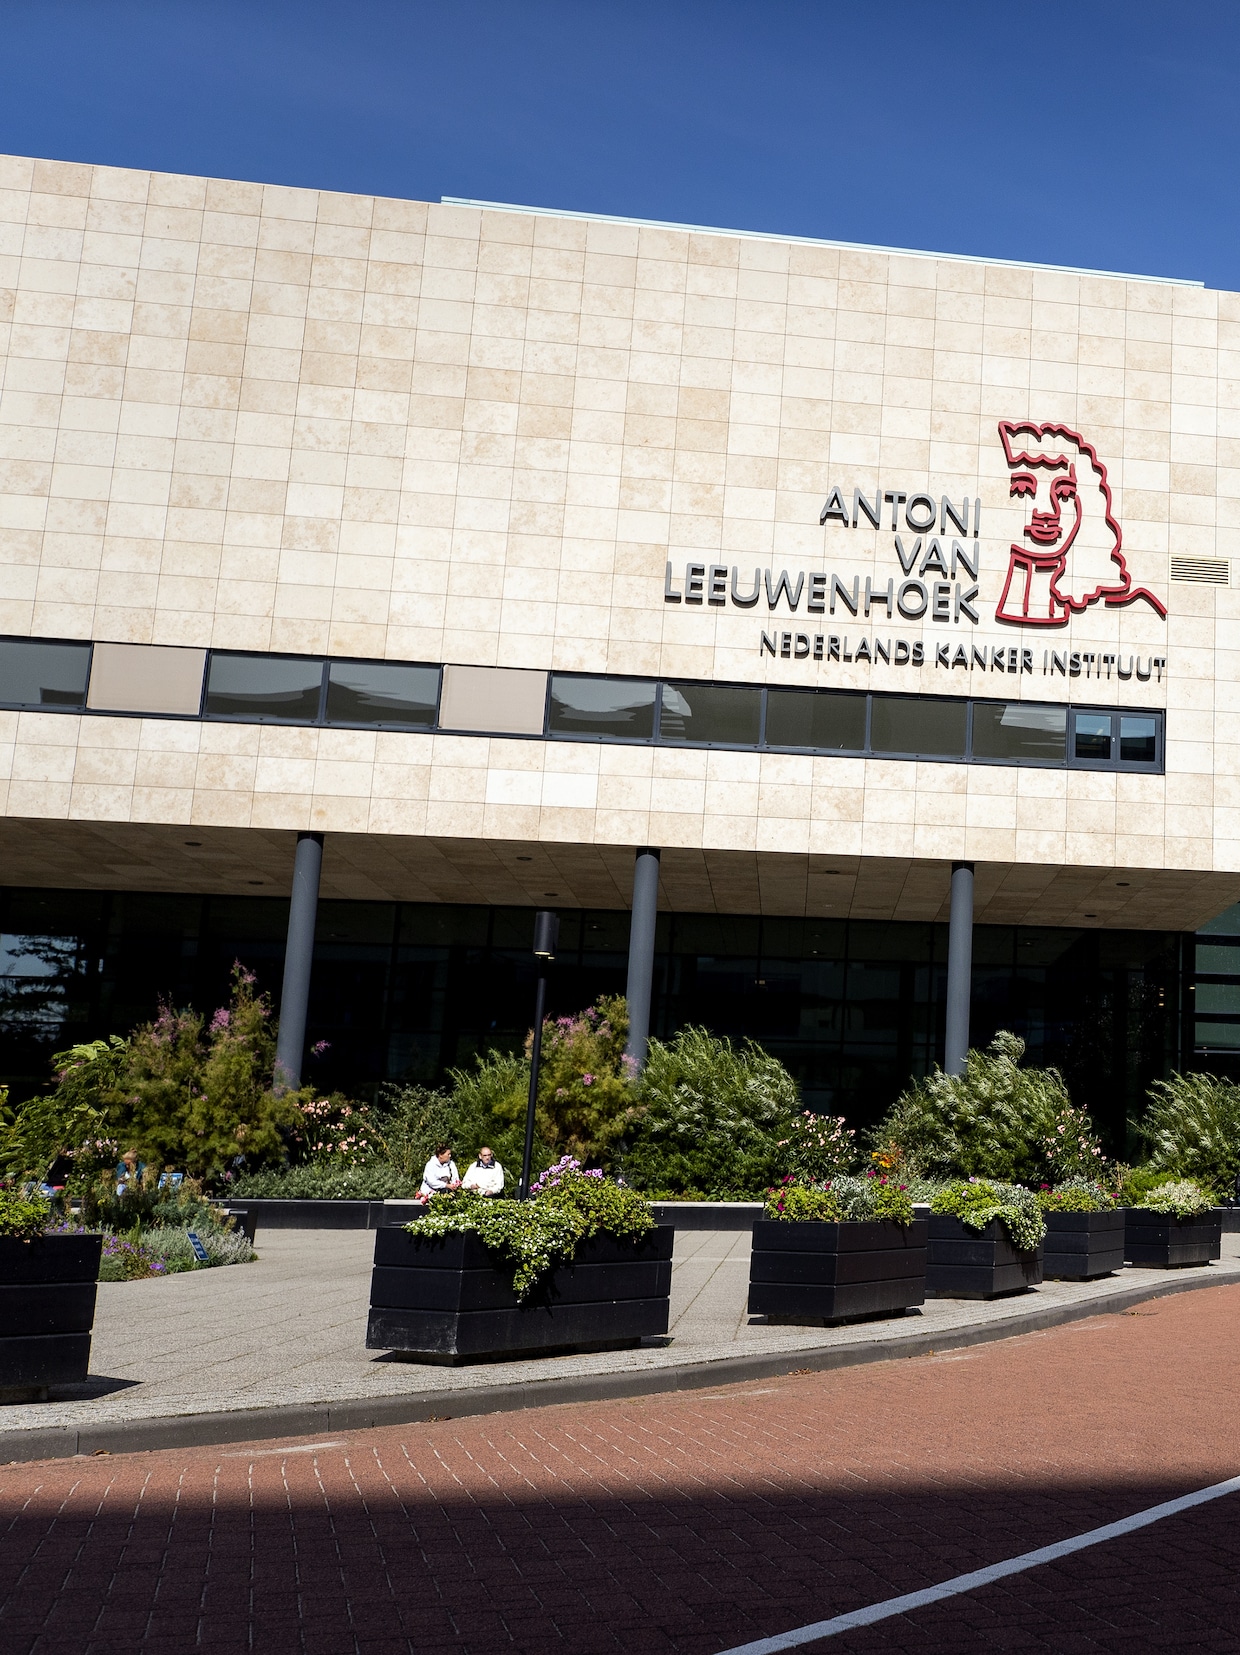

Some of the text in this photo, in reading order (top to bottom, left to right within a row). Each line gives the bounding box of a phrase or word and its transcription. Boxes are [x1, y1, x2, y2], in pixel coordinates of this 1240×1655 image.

[820, 486, 980, 538] ANTONI
[894, 535, 980, 581] VAN
[664, 561, 980, 625] LEEUWENHOEK
[760, 630, 1167, 683] NEDERLANDS KANKER INSTITUUT
